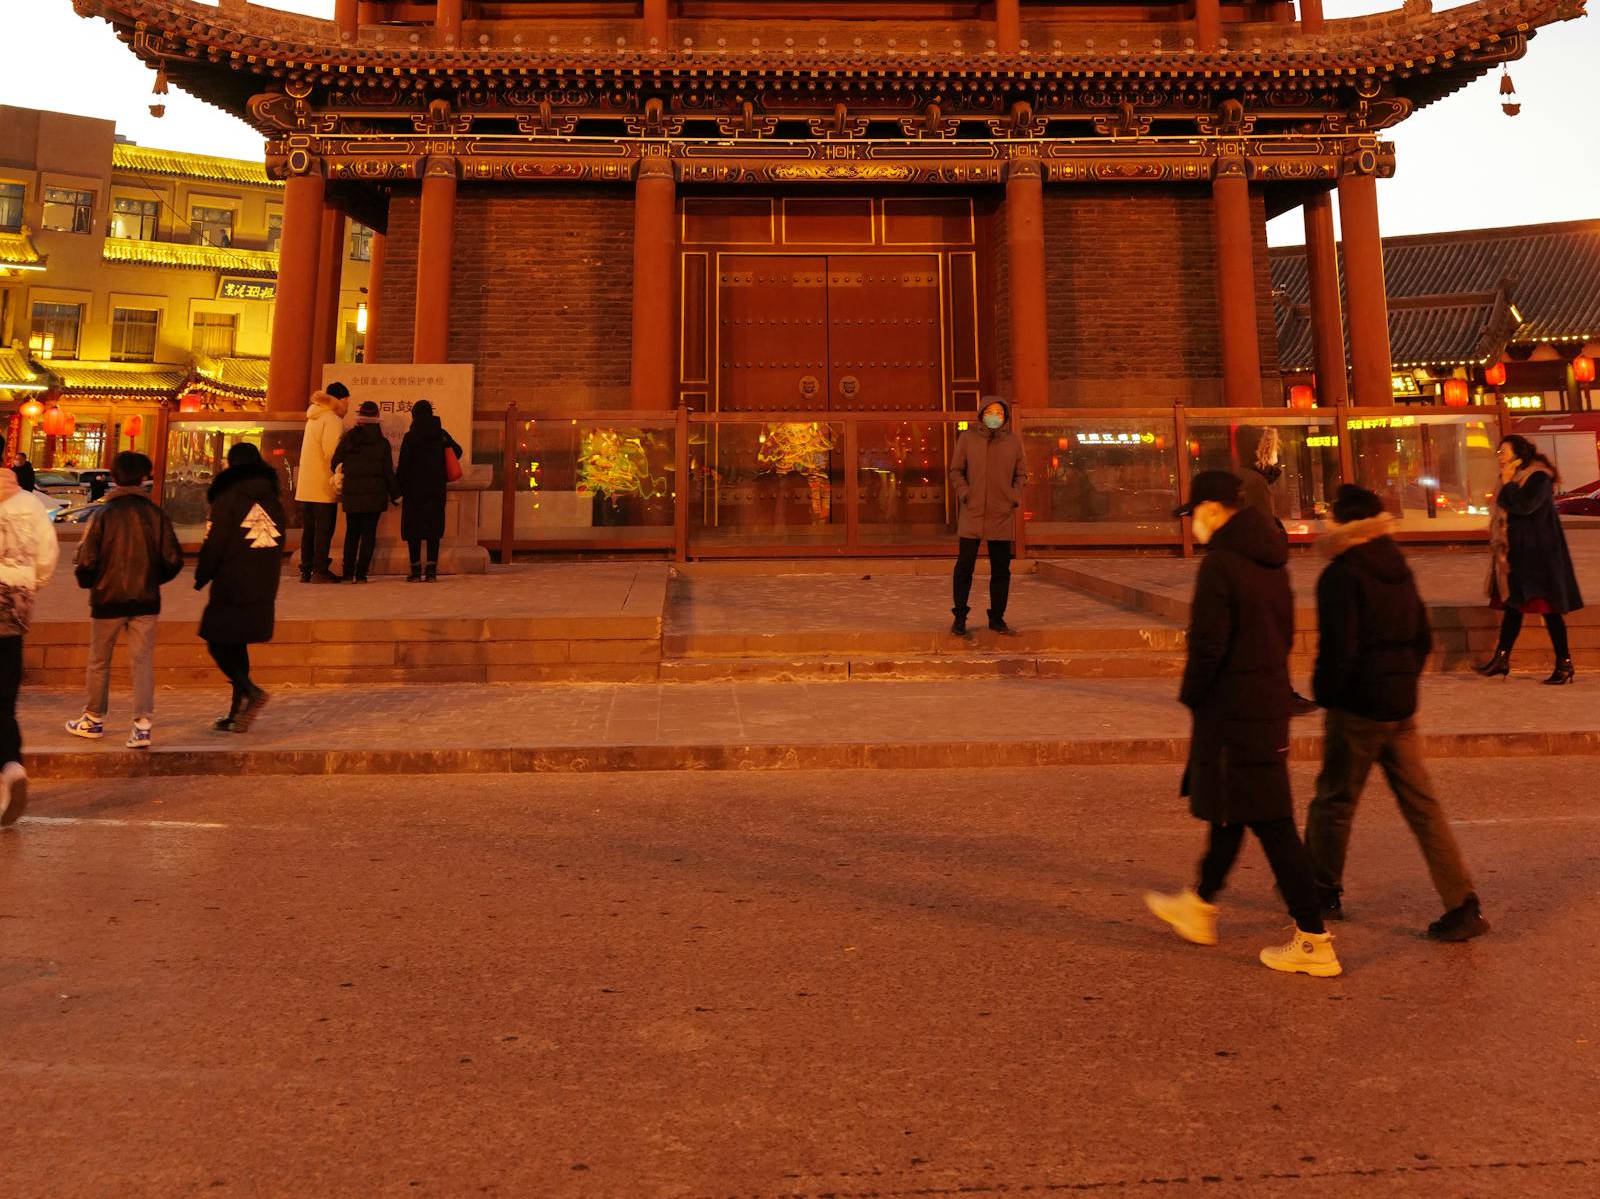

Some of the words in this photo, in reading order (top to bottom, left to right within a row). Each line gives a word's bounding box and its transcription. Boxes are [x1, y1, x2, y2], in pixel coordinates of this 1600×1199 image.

[352, 376, 446, 386] 全国重点文物保护单位
